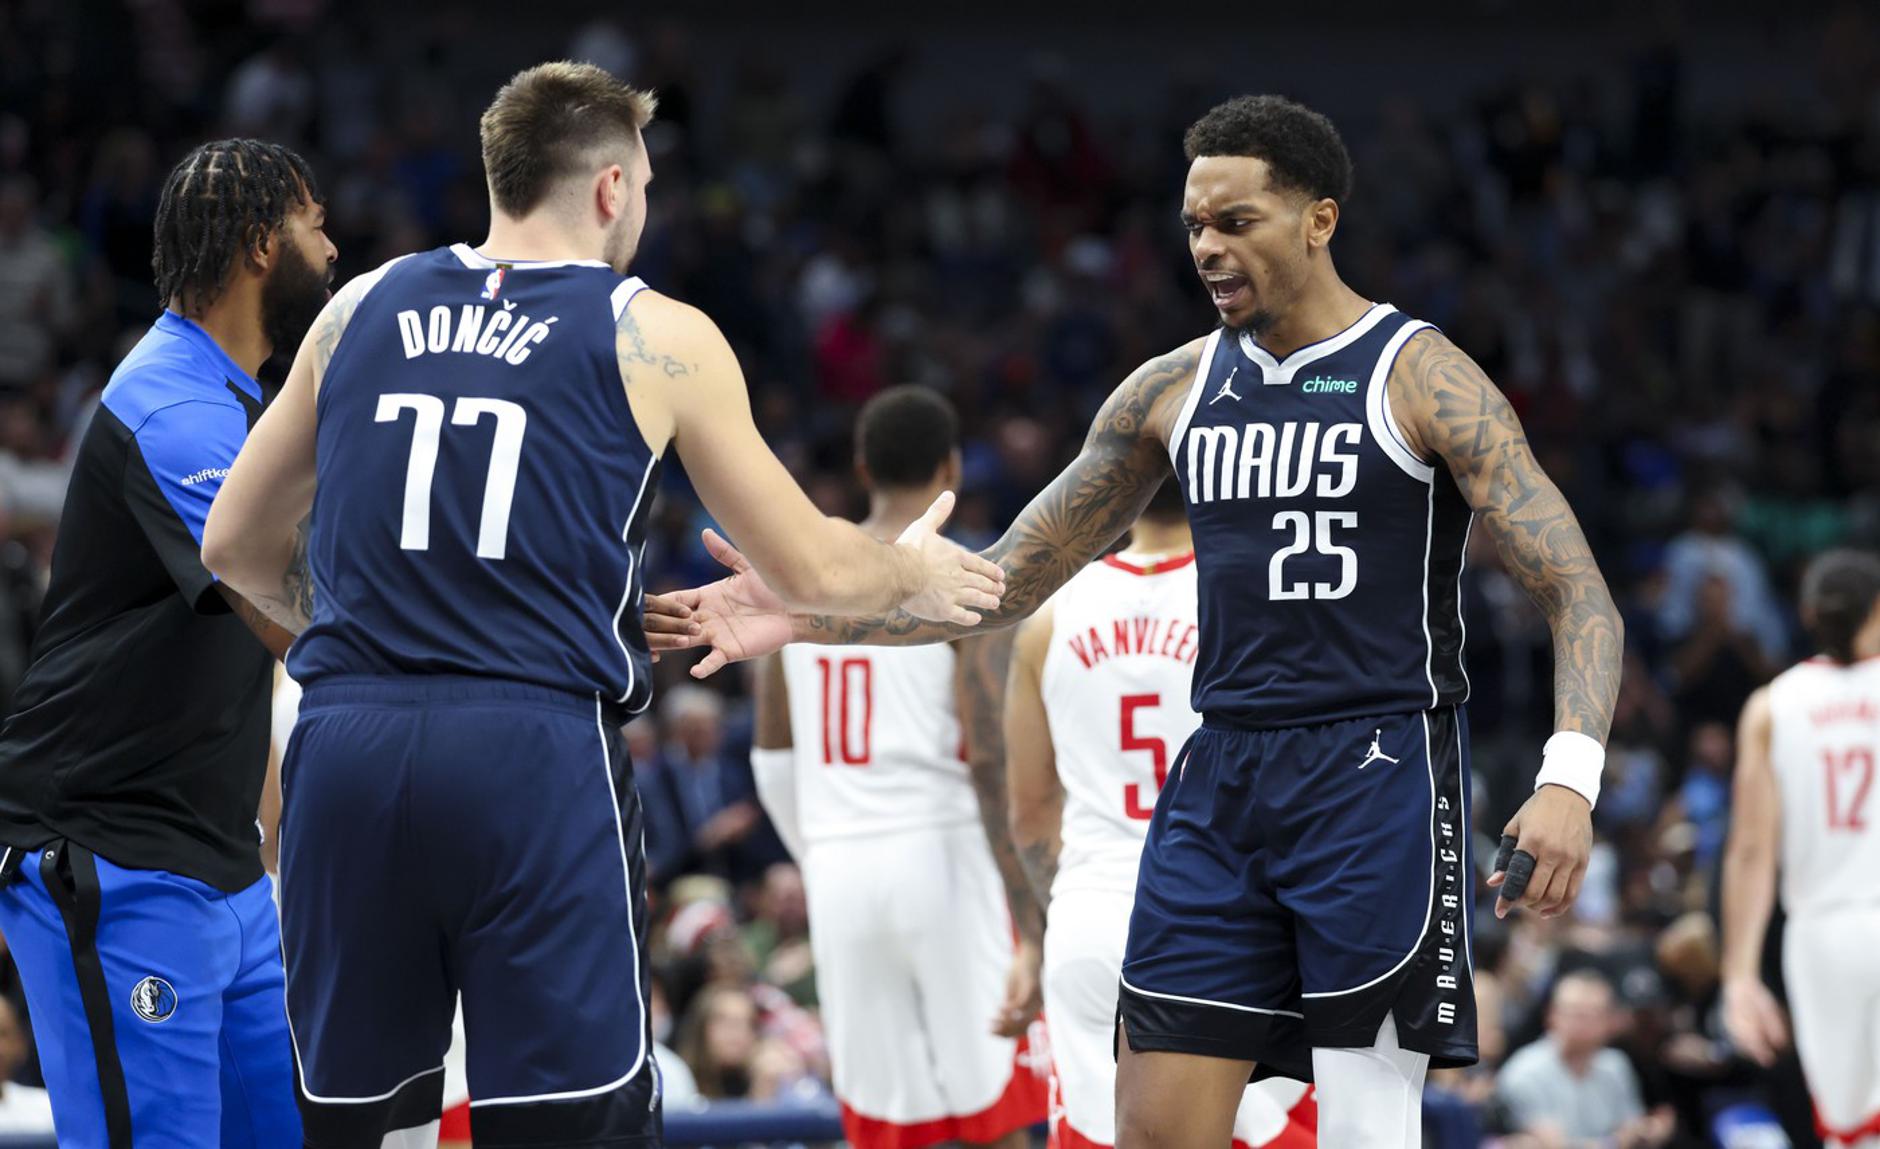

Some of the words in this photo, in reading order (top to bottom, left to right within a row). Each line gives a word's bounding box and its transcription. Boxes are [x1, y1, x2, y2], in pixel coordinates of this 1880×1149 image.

[397, 298, 559, 366] DONČIĆ
[1302, 375, 1358, 393] chime
[374, 393, 527, 560] 77
[1187, 421, 1364, 504] MAVS
[1268, 510, 1358, 601] 25
[816, 657, 872, 765] 10
[1120, 693, 1168, 821] 5
[1822, 746, 1876, 831] 12
[1436, 796, 1459, 1025] MAVERICKS
